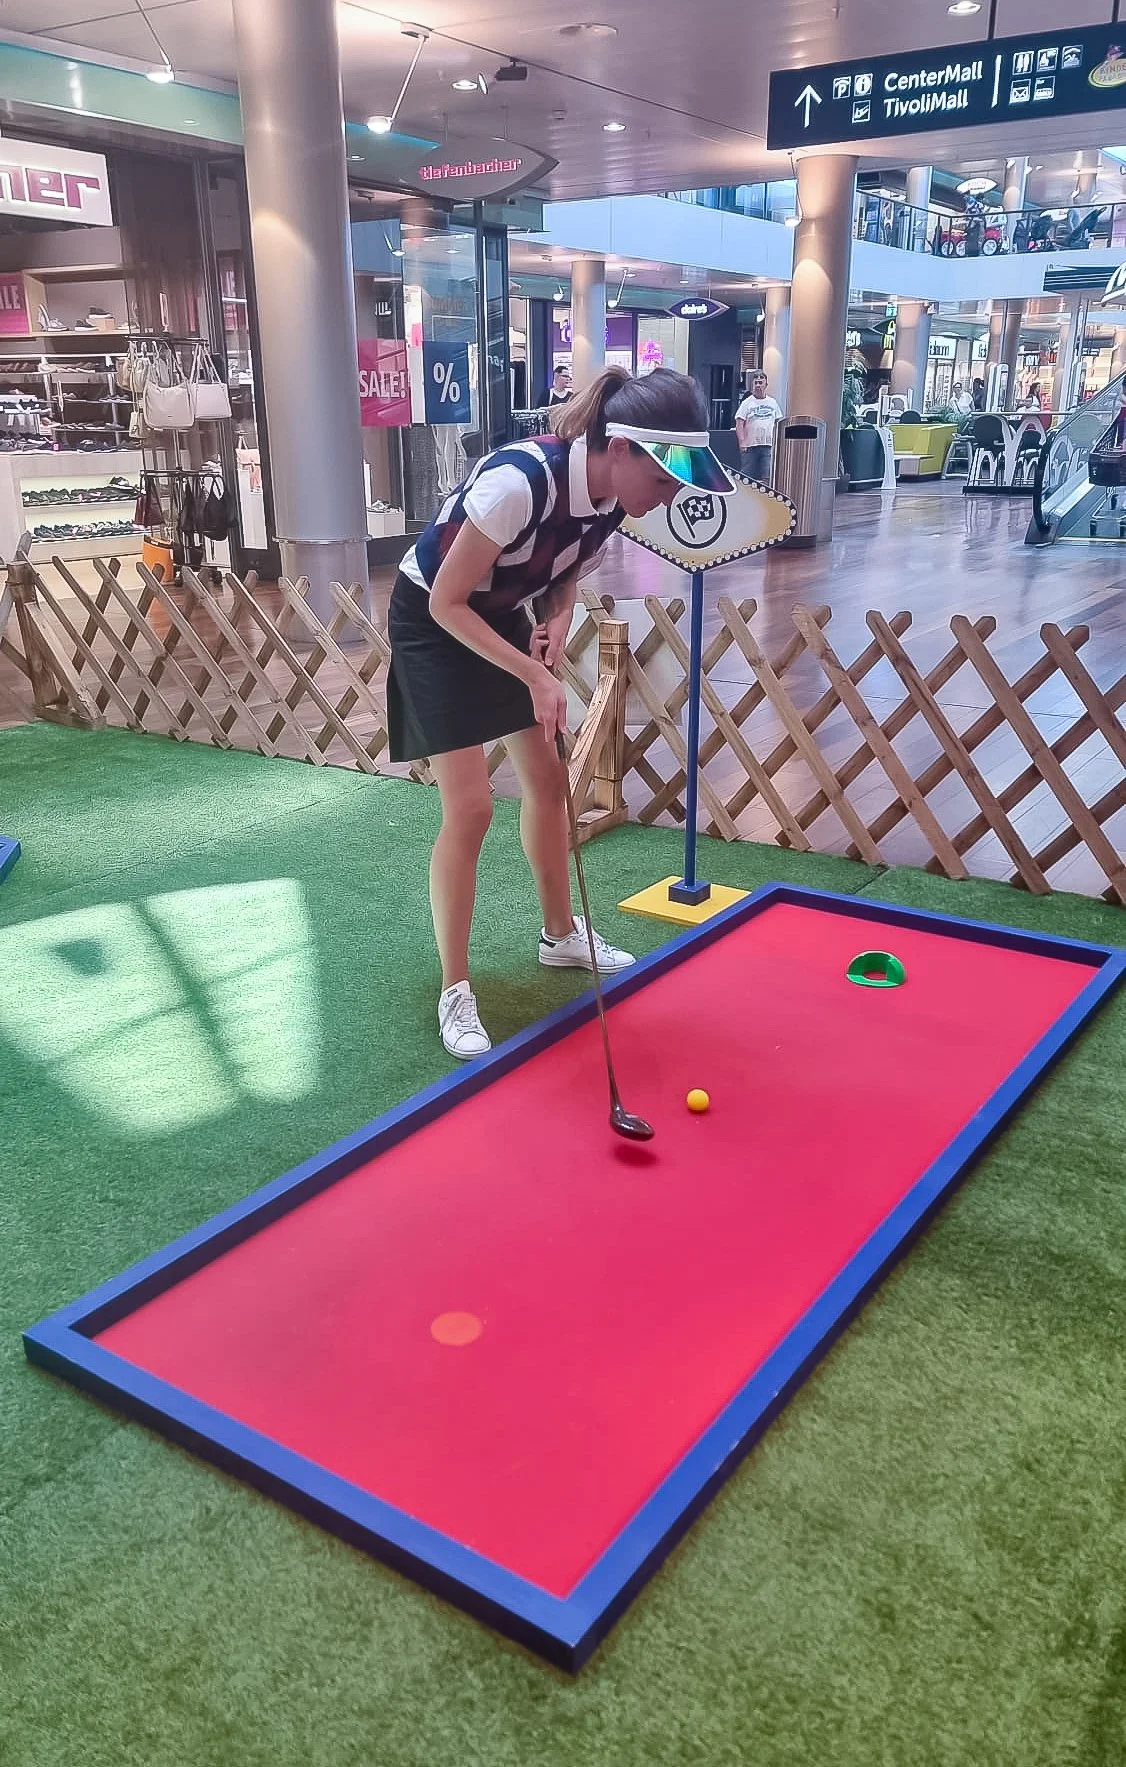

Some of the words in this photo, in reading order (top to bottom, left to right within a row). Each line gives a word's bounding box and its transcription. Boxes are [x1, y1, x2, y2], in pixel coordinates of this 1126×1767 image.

[884, 60, 983, 92] CenterMall
[883, 88, 969, 118] TivoliMall
[359, 369, 406, 399] SALE!
[433, 362, 461, 403] %
